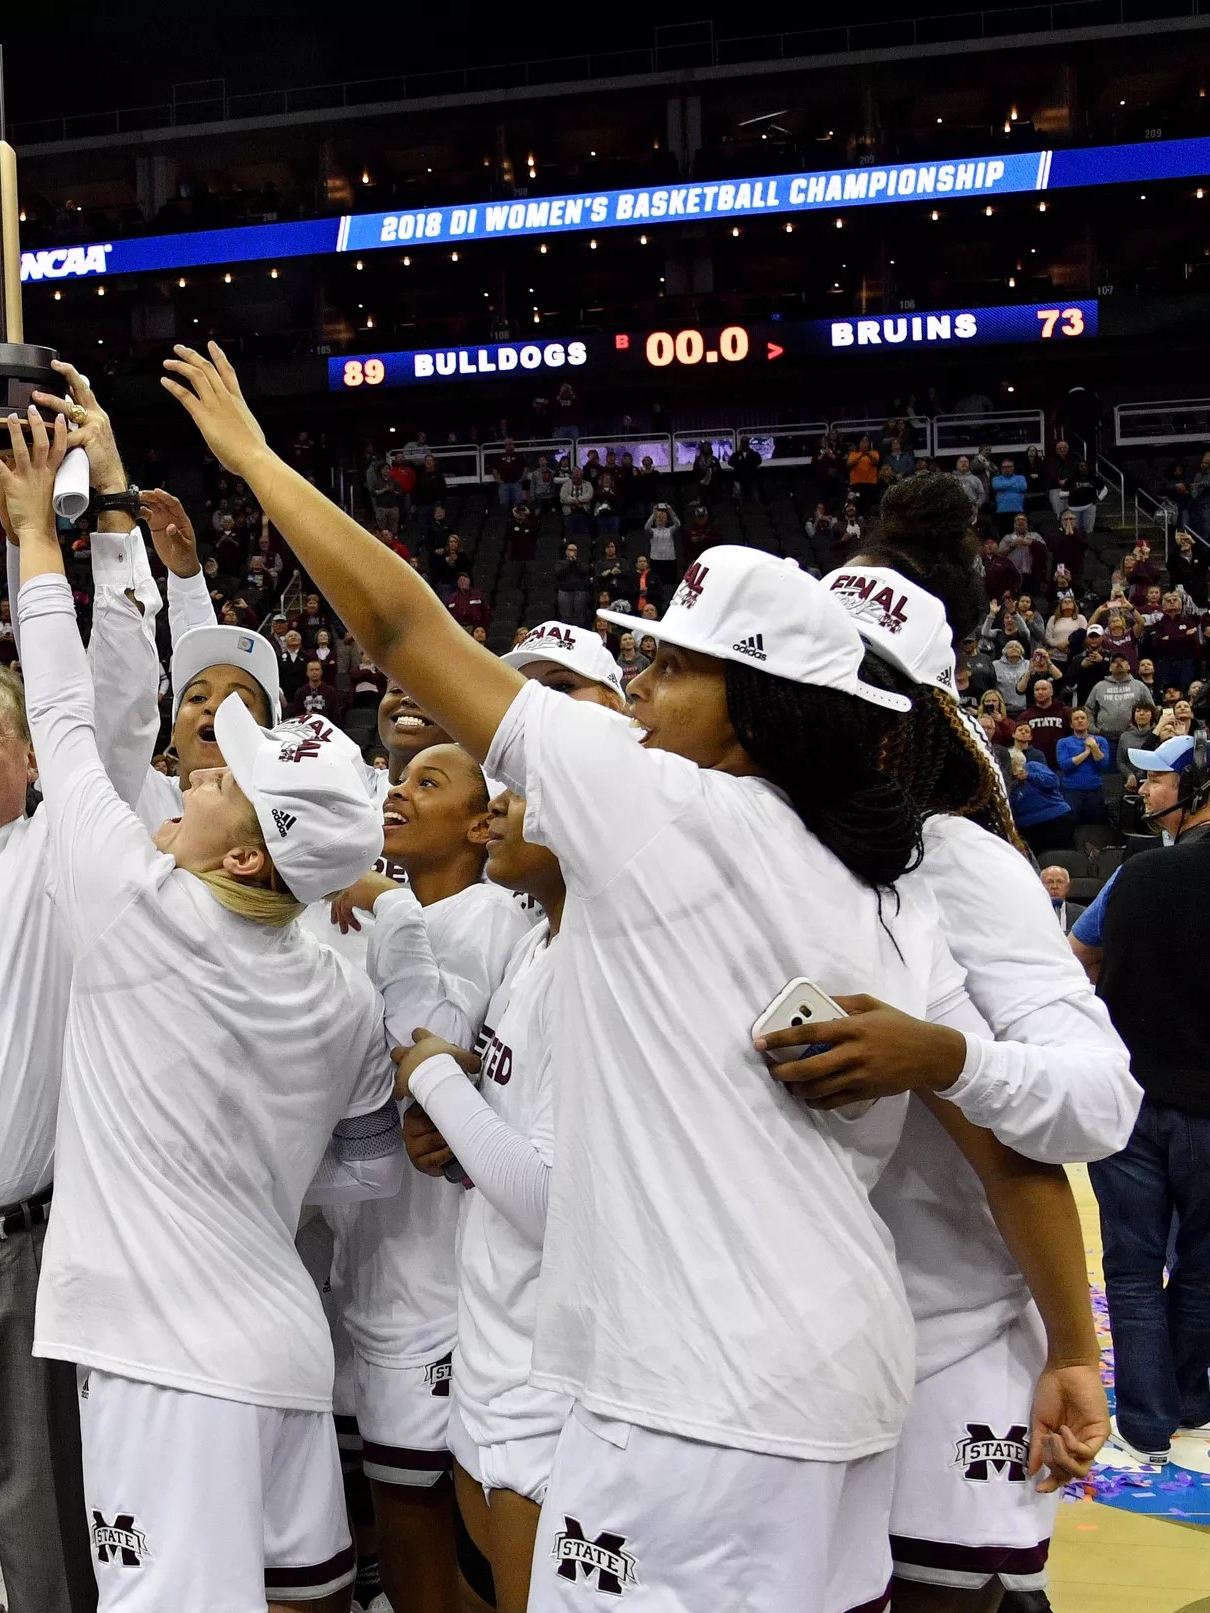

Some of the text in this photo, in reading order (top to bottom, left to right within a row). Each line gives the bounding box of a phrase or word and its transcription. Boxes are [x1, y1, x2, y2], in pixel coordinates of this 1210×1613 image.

[1144, 128, 1162, 139] 209
[380, 160, 1005, 242] 2018 DI WOMEN'S BASKETBALL CHAMPIONSHIP
[20, 244, 108, 281] NCAA
[615, 334, 629, 349] B
[831, 307, 1086, 347] BRUINS 73
[646, 326, 749, 368] 00.0
[343, 341, 587, 387] 89 BULLDOGS
[830, 575, 908, 623] FINAL
[732, 643, 767, 662] adidas
[1029, 717, 1063, 729] STATE
[271, 808, 288, 839] adidas
[970, 1443, 1023, 1463] STATE
[95, 1528, 136, 1547] STATE
[562, 1542, 622, 1575] STATE
